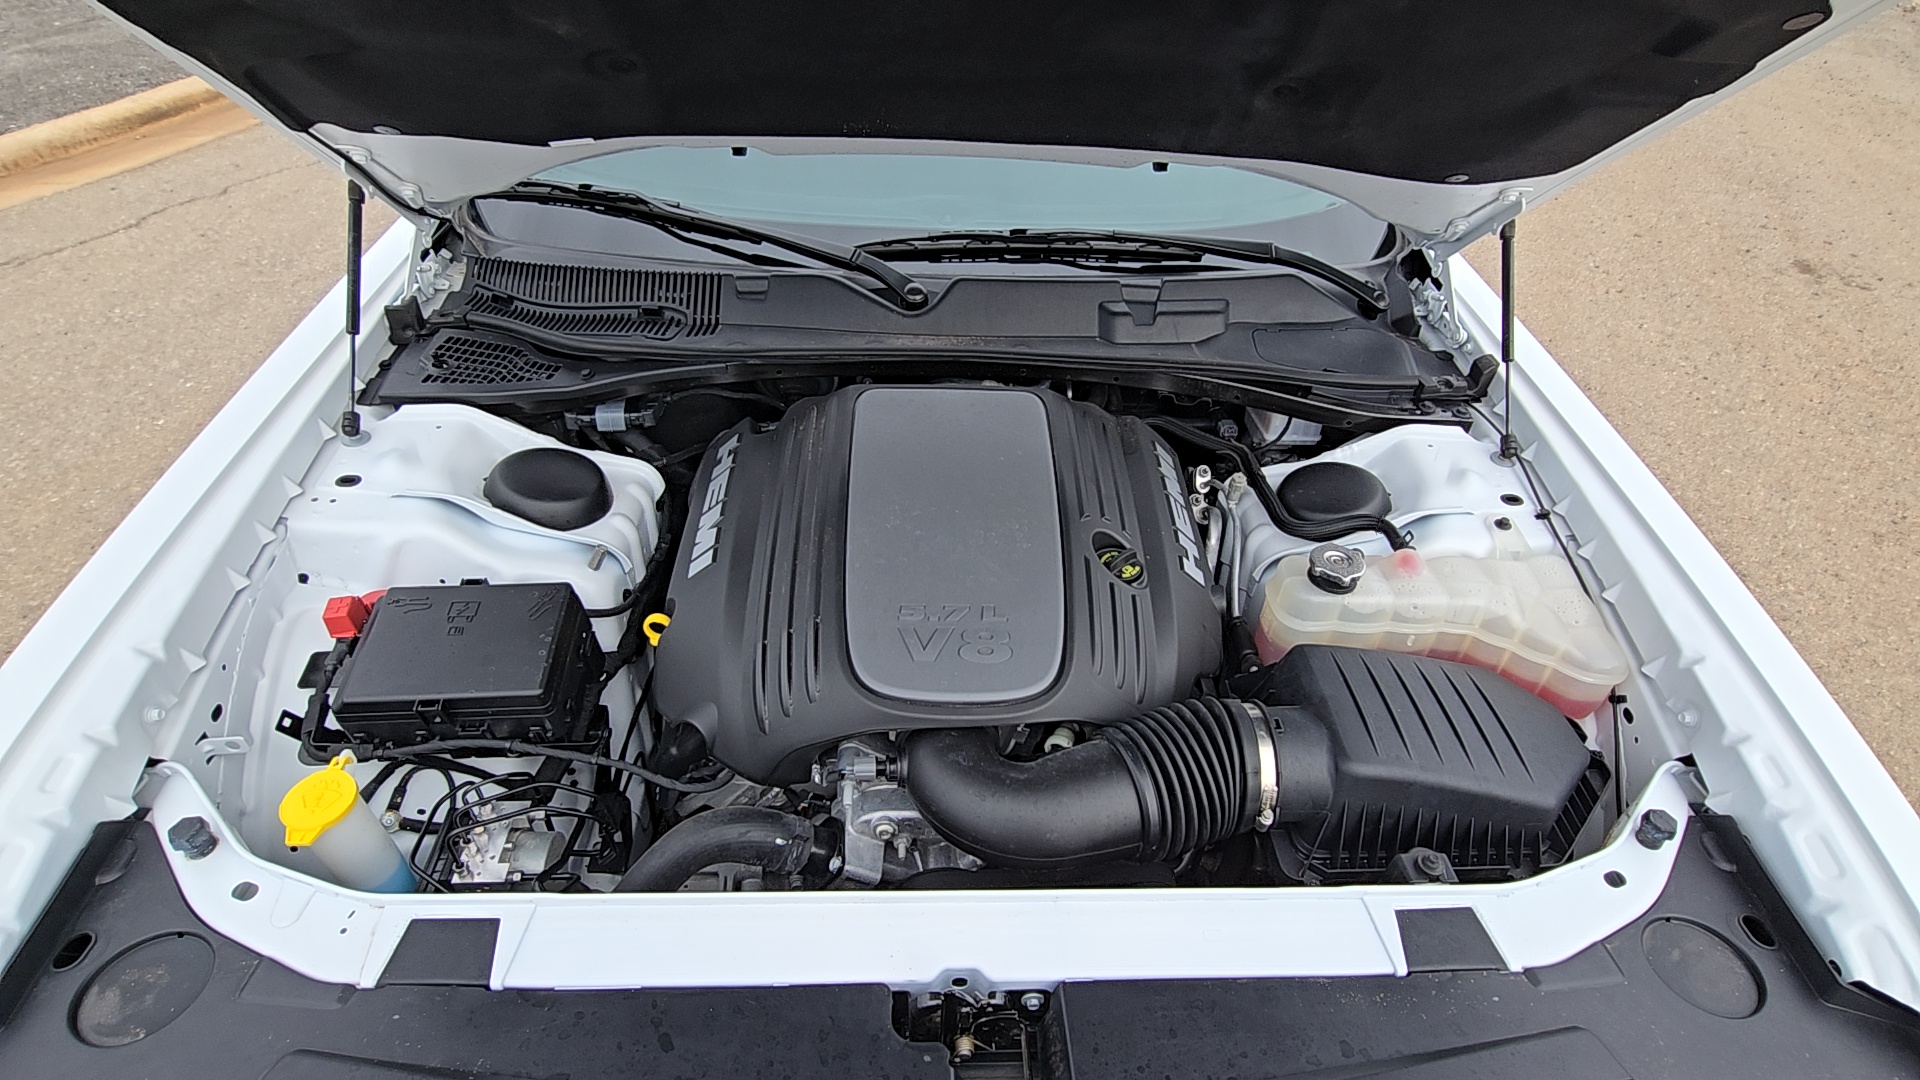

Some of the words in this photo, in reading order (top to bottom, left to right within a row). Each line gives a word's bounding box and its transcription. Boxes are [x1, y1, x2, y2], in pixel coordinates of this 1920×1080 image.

[687, 433, 740, 579] HEMI
[1154, 440, 1206, 588] HEMI
[897, 625, 1014, 663] V8
